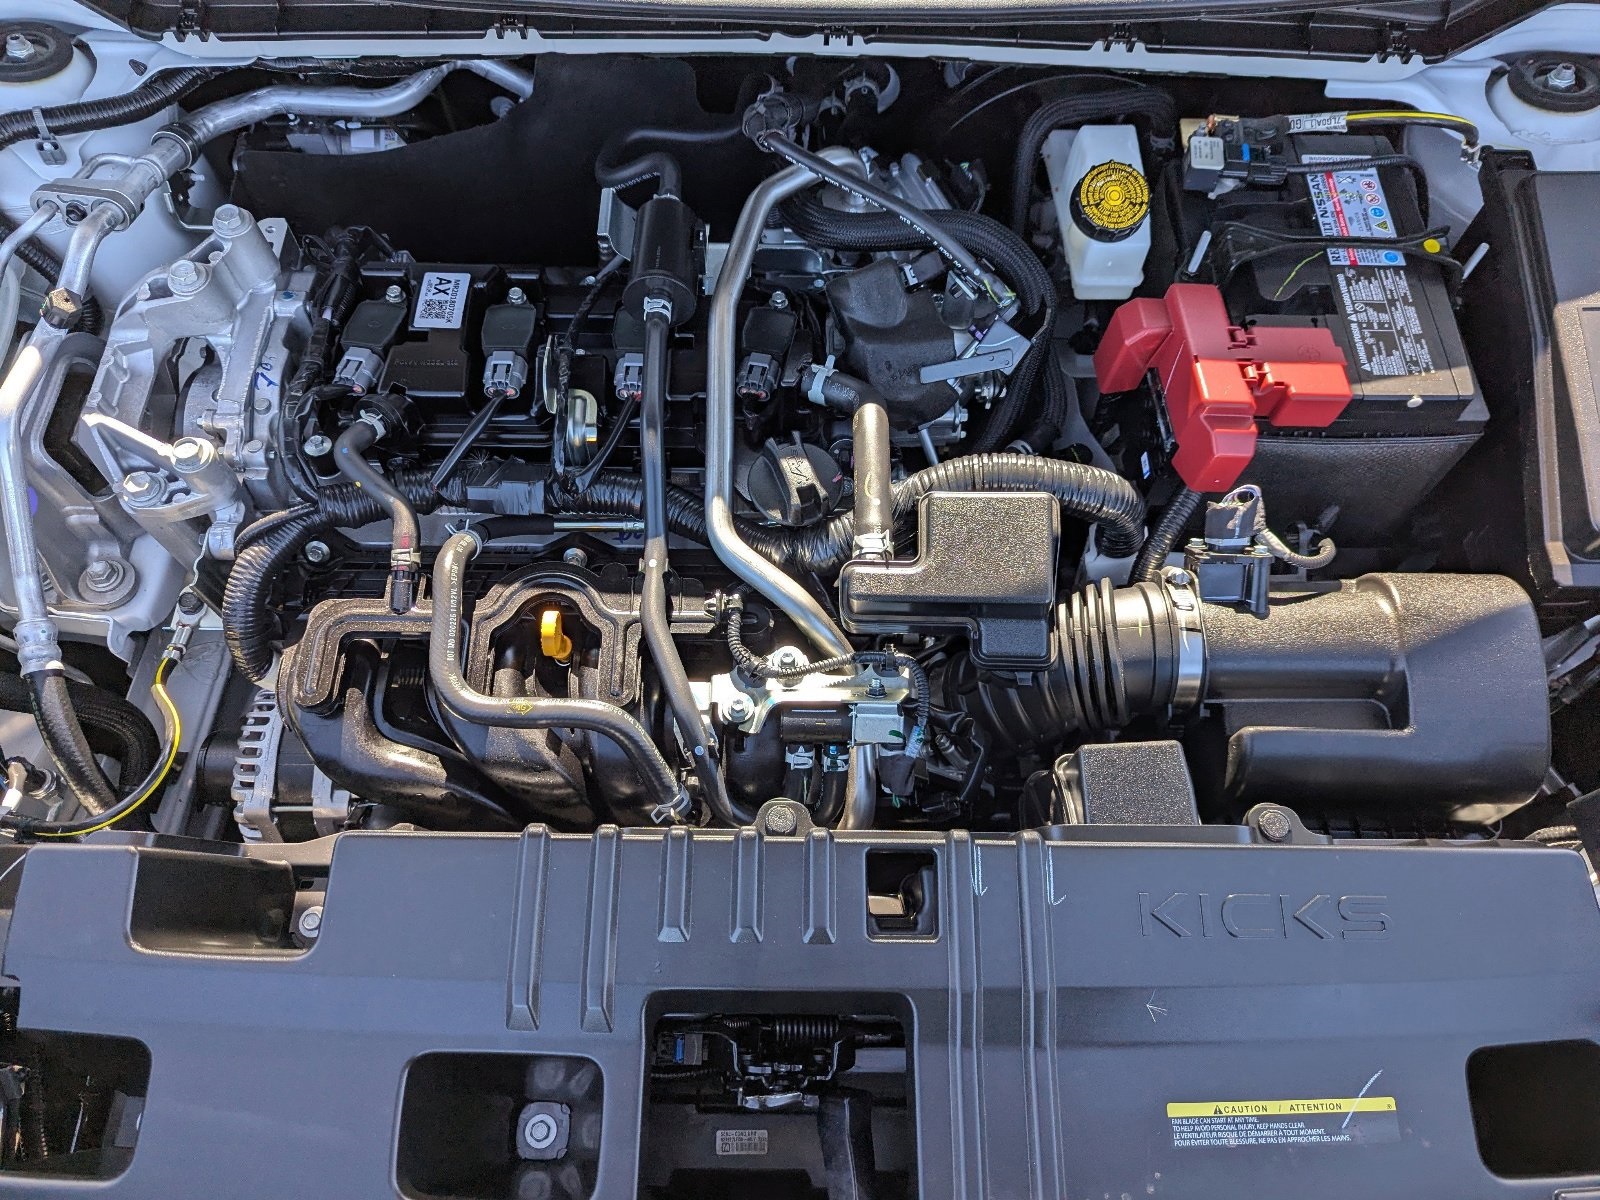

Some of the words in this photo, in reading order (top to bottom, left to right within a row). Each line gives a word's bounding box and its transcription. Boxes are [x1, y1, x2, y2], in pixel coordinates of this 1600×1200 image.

[1310, 174, 1330, 219] NISSAN
[432, 276, 452, 296] AX
[1138, 892, 1392, 940] KICKS
[1224, 1104, 1268, 1113] CAUTION
[1289, 1102, 1342, 1111] ATTENTION
